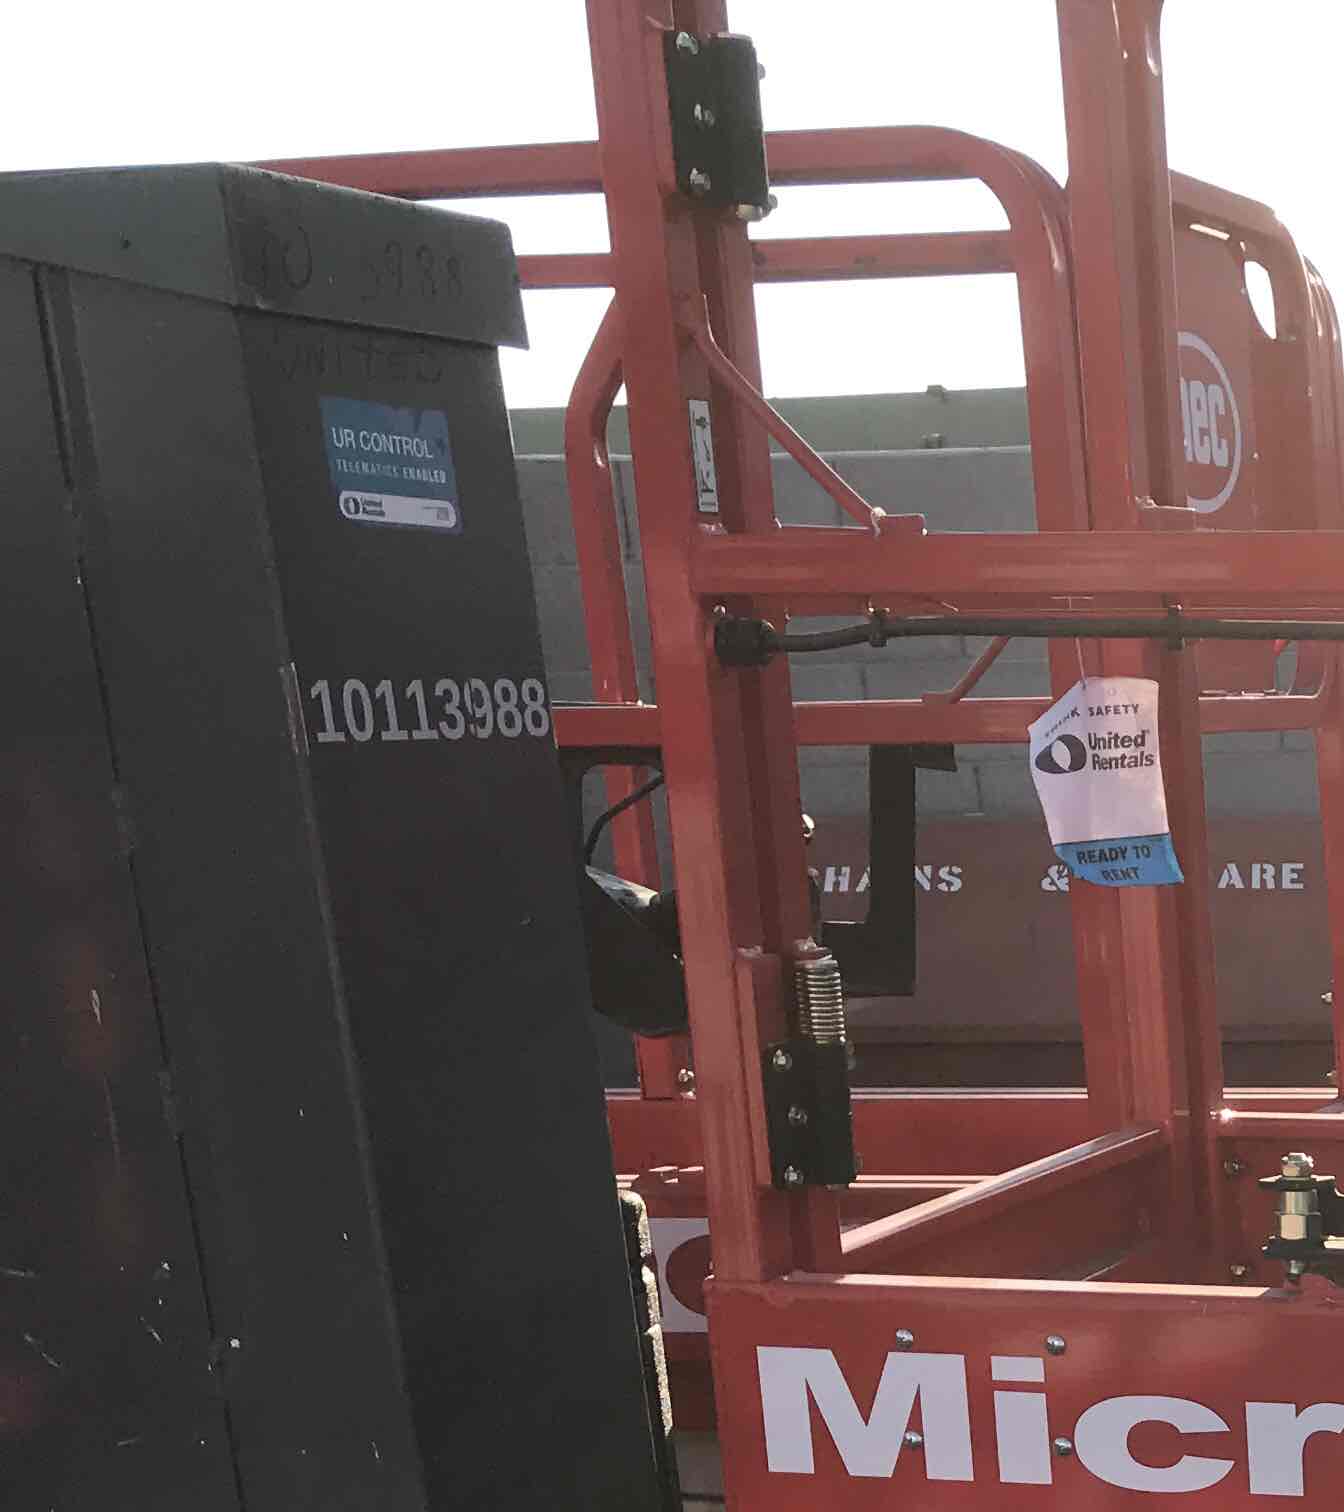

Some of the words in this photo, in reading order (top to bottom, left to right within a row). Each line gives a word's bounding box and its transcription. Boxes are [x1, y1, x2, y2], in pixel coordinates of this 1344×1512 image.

[1181, 376, 1229, 467] EC
[331, 426, 356, 449] UR
[359, 430, 434, 458] CONTROL
[310, 677, 550, 743] 10113988
[1088, 703, 1140, 717] SAFETY
[1088, 730, 1146, 751] United
[1092, 750, 1155, 772] Rentals
[1076, 846, 1128, 865] READY
[1135, 844, 1151, 859] TO
[1102, 866, 1140, 882] RENT
[1217, 863, 1305, 890] ARE
